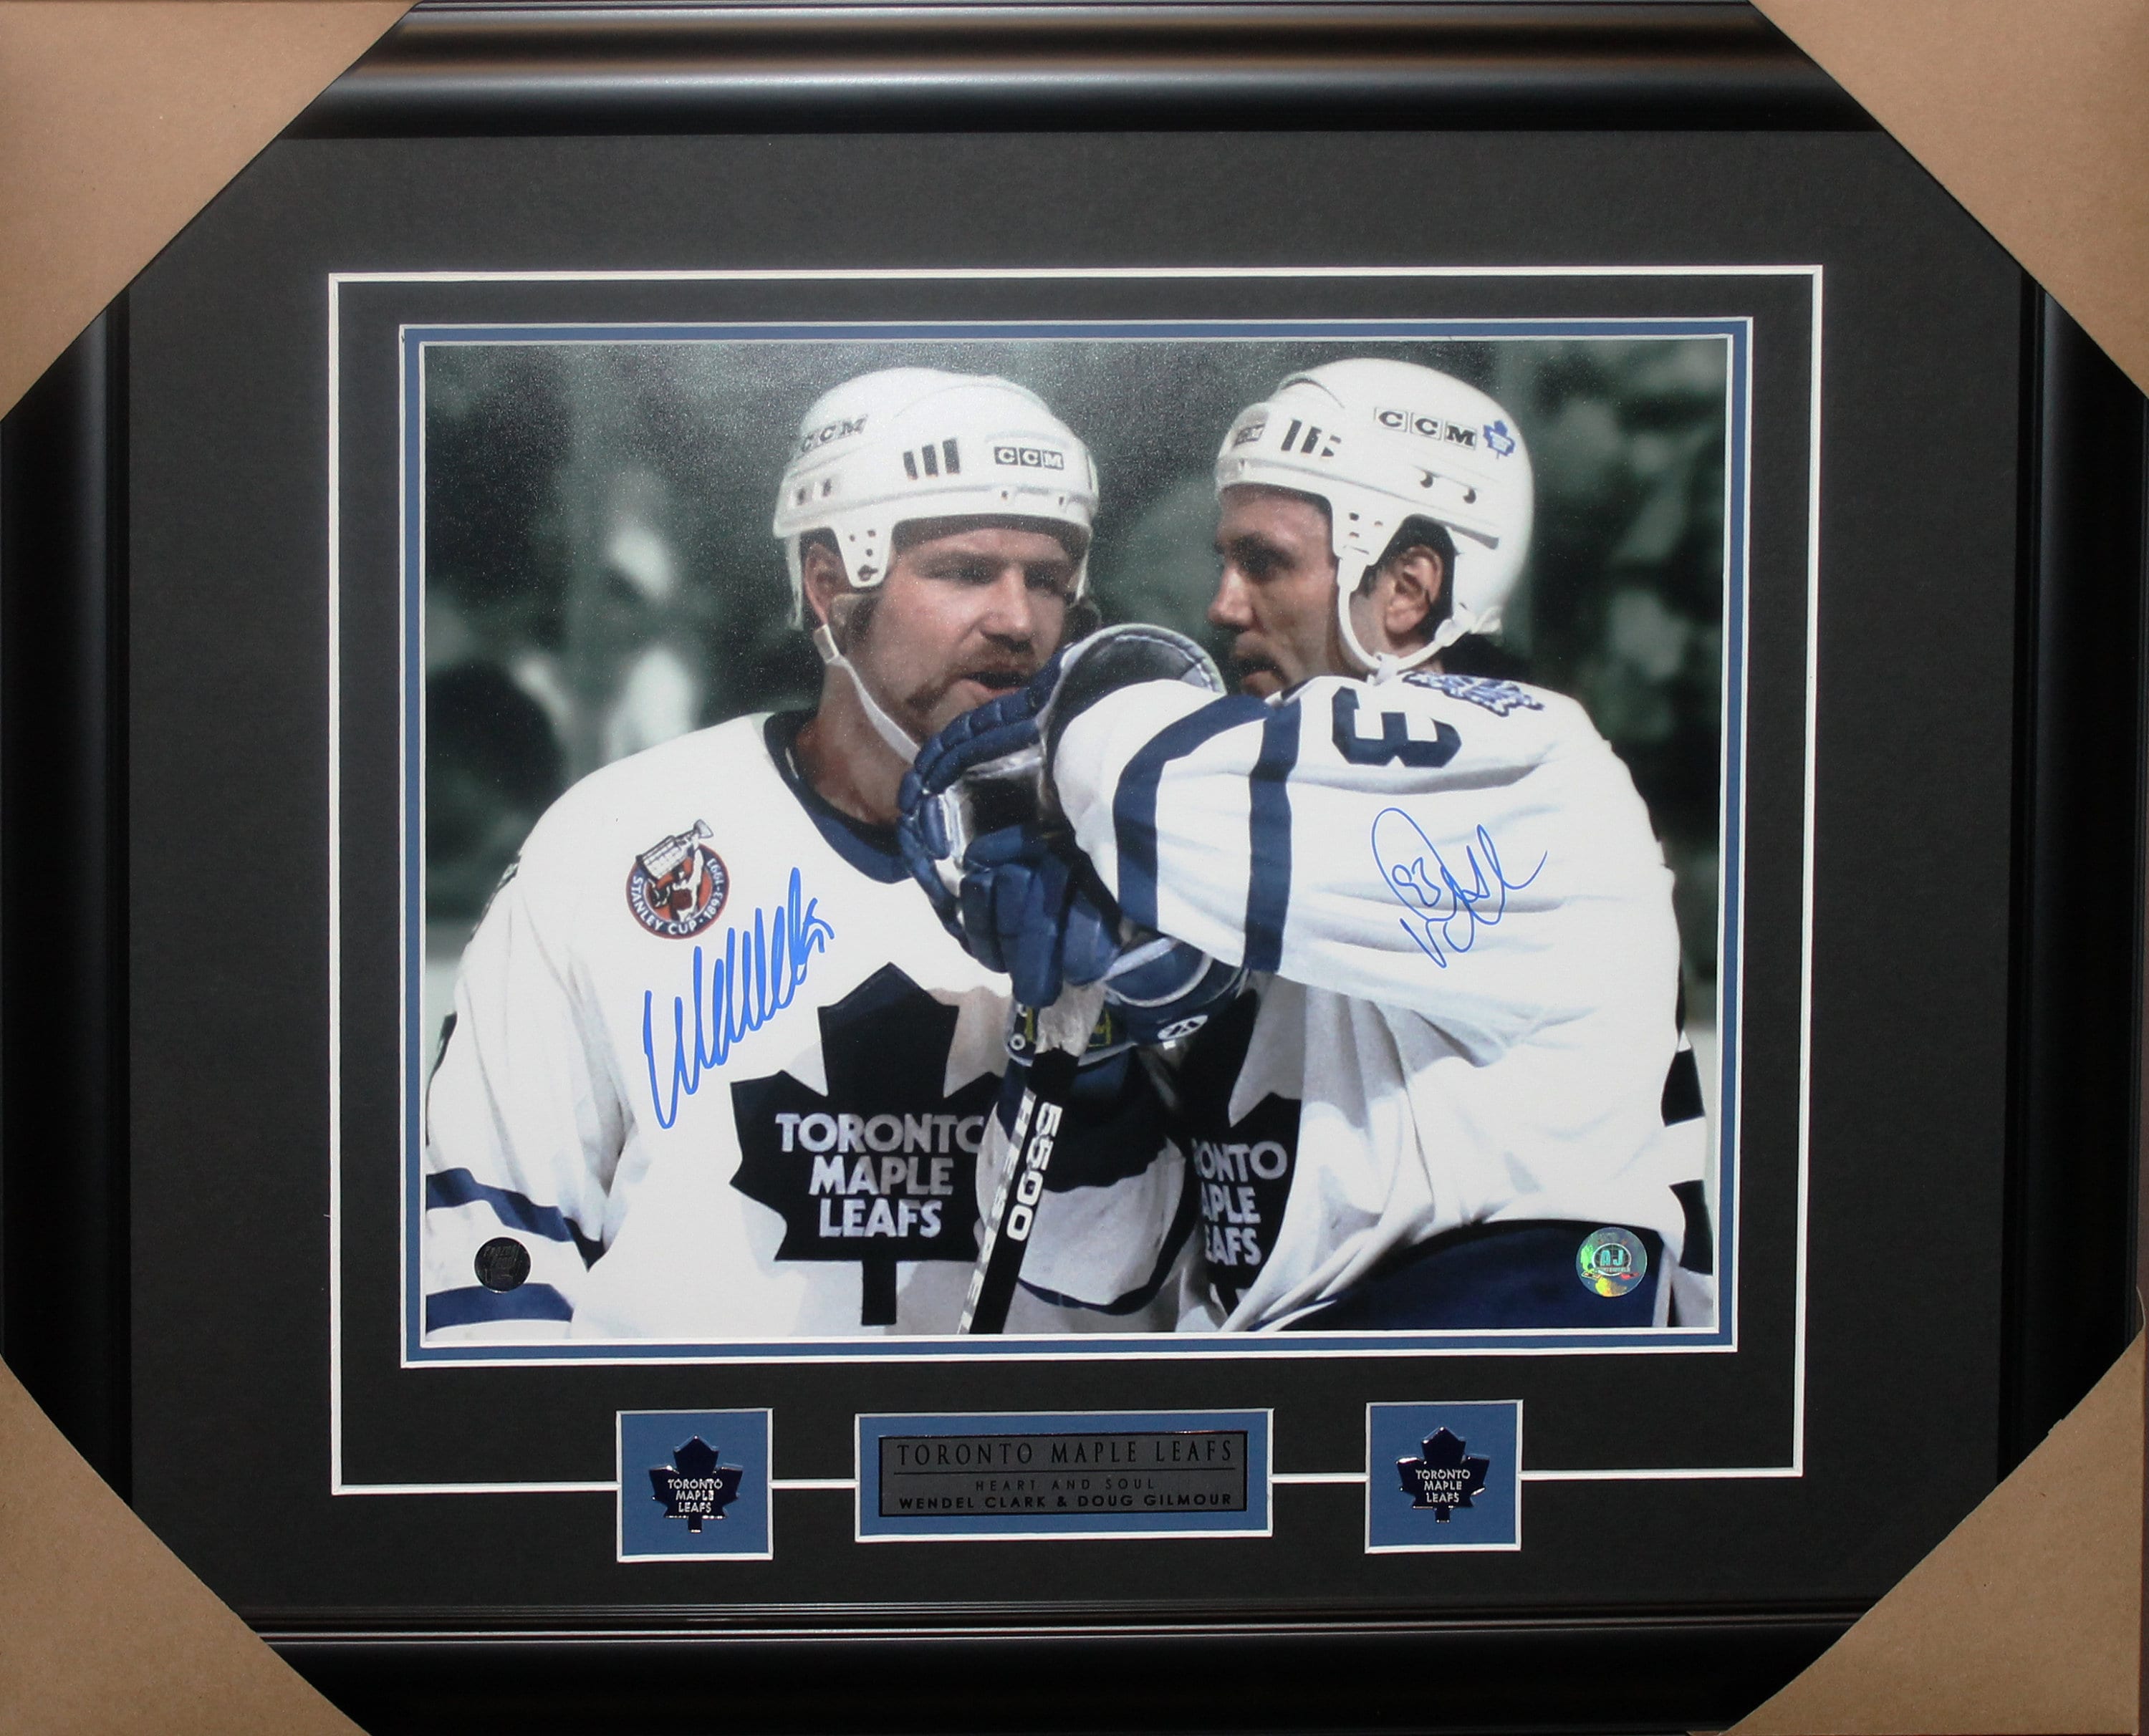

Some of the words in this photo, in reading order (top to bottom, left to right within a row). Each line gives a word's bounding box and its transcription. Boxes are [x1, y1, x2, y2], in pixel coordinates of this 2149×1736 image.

[1377, 409, 1476, 448] CCM
[995, 446, 1064, 470] CCM
[630, 875, 664, 931] STANLEY
[668, 920, 698, 935] CUP
[809, 1155, 954, 1195] MAPLE
[1006, 1101, 1063, 1242] 5500
[819, 1199, 942, 1238] LEAFS
[897, 1442, 1032, 1465] TORONTO
[1052, 1441, 1136, 1463] MAPLE
[1156, 1440, 1231, 1462] LEAFS
[1415, 1469, 1471, 1480] TORONTO
[668, 1478, 723, 1490] TORONTO
[976, 1480, 1035, 1492] HEART
[1052, 1479, 1090, 1490] AND
[1105, 1478, 1155, 1490] SOUL
[1423, 1480, 1462, 1491] MAPLE
[676, 1490, 714, 1501] MAPLE
[899, 1496, 974, 1510] WENDEL
[985, 1495, 1046, 1508] CLARK
[1057, 1495, 1067, 1507] &
[1078, 1494, 1133, 1507] DOUG
[1143, 1493, 1232, 1506] GILMOUR
[1426, 1492, 1460, 1503] LEAFS
[678, 1501, 712, 1513] LEAFS
